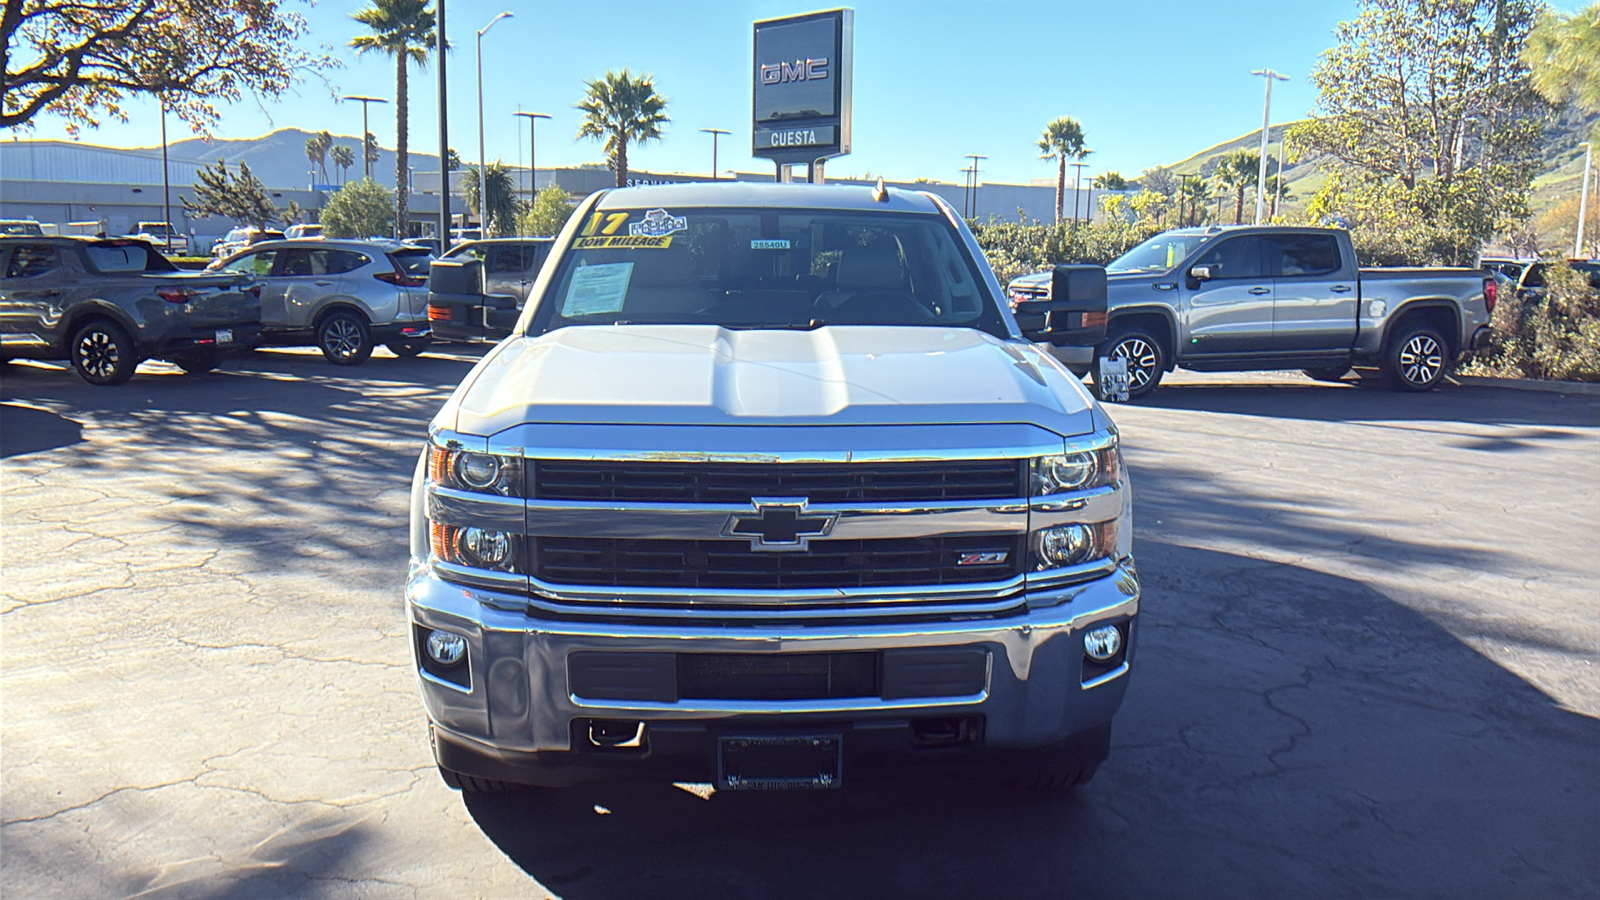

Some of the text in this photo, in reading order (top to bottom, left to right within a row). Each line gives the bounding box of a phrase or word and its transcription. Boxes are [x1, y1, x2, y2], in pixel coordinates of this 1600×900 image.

[761, 57, 828, 85] GMC
[771, 130, 816, 146] CUESTA
[577, 236, 667, 247] LOW MILEAGE
[958, 552, 1008, 565] Z71
